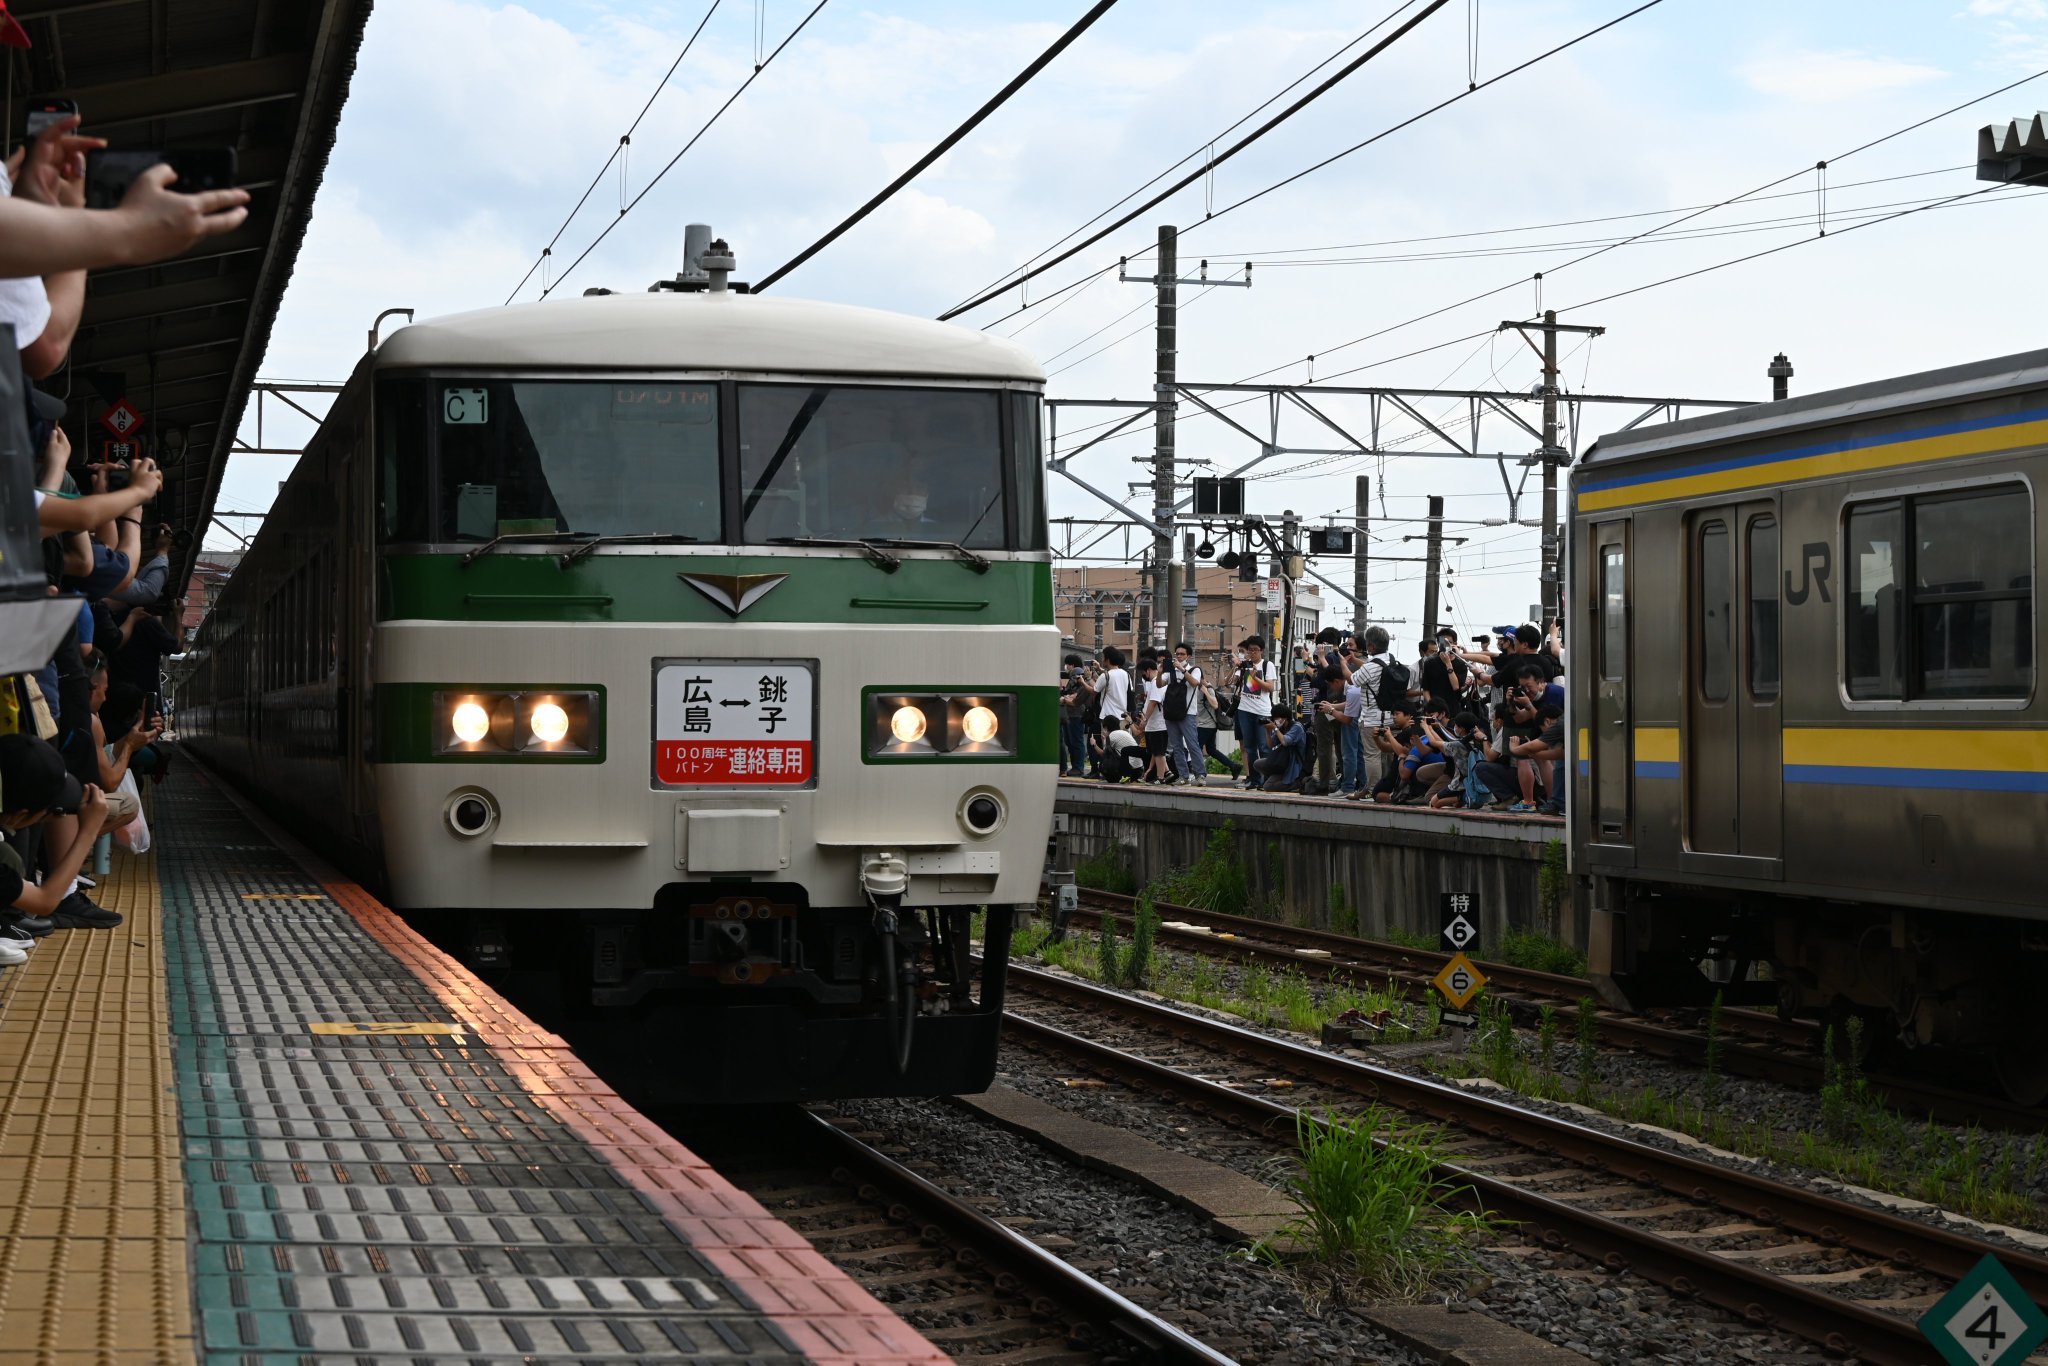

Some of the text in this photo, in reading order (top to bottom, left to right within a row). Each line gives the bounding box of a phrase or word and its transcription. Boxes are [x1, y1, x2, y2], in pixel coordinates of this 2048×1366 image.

[117, 411, 127, 420] N
[117, 421, 126, 430] 6
[113, 442, 130, 457] 特
[1784, 541, 1832, 606] JR
[682, 675, 713, 734] 広島
[758, 675, 788, 734] 銚子
[666, 747, 727, 759] 100周年
[728, 747, 803, 775] 連絡専用
[1450, 893, 1470, 913] 特
[1452, 921, 1468, 943] 6
[1452, 972, 1469, 990] 6
[1964, 1305, 2007, 1350] 4
